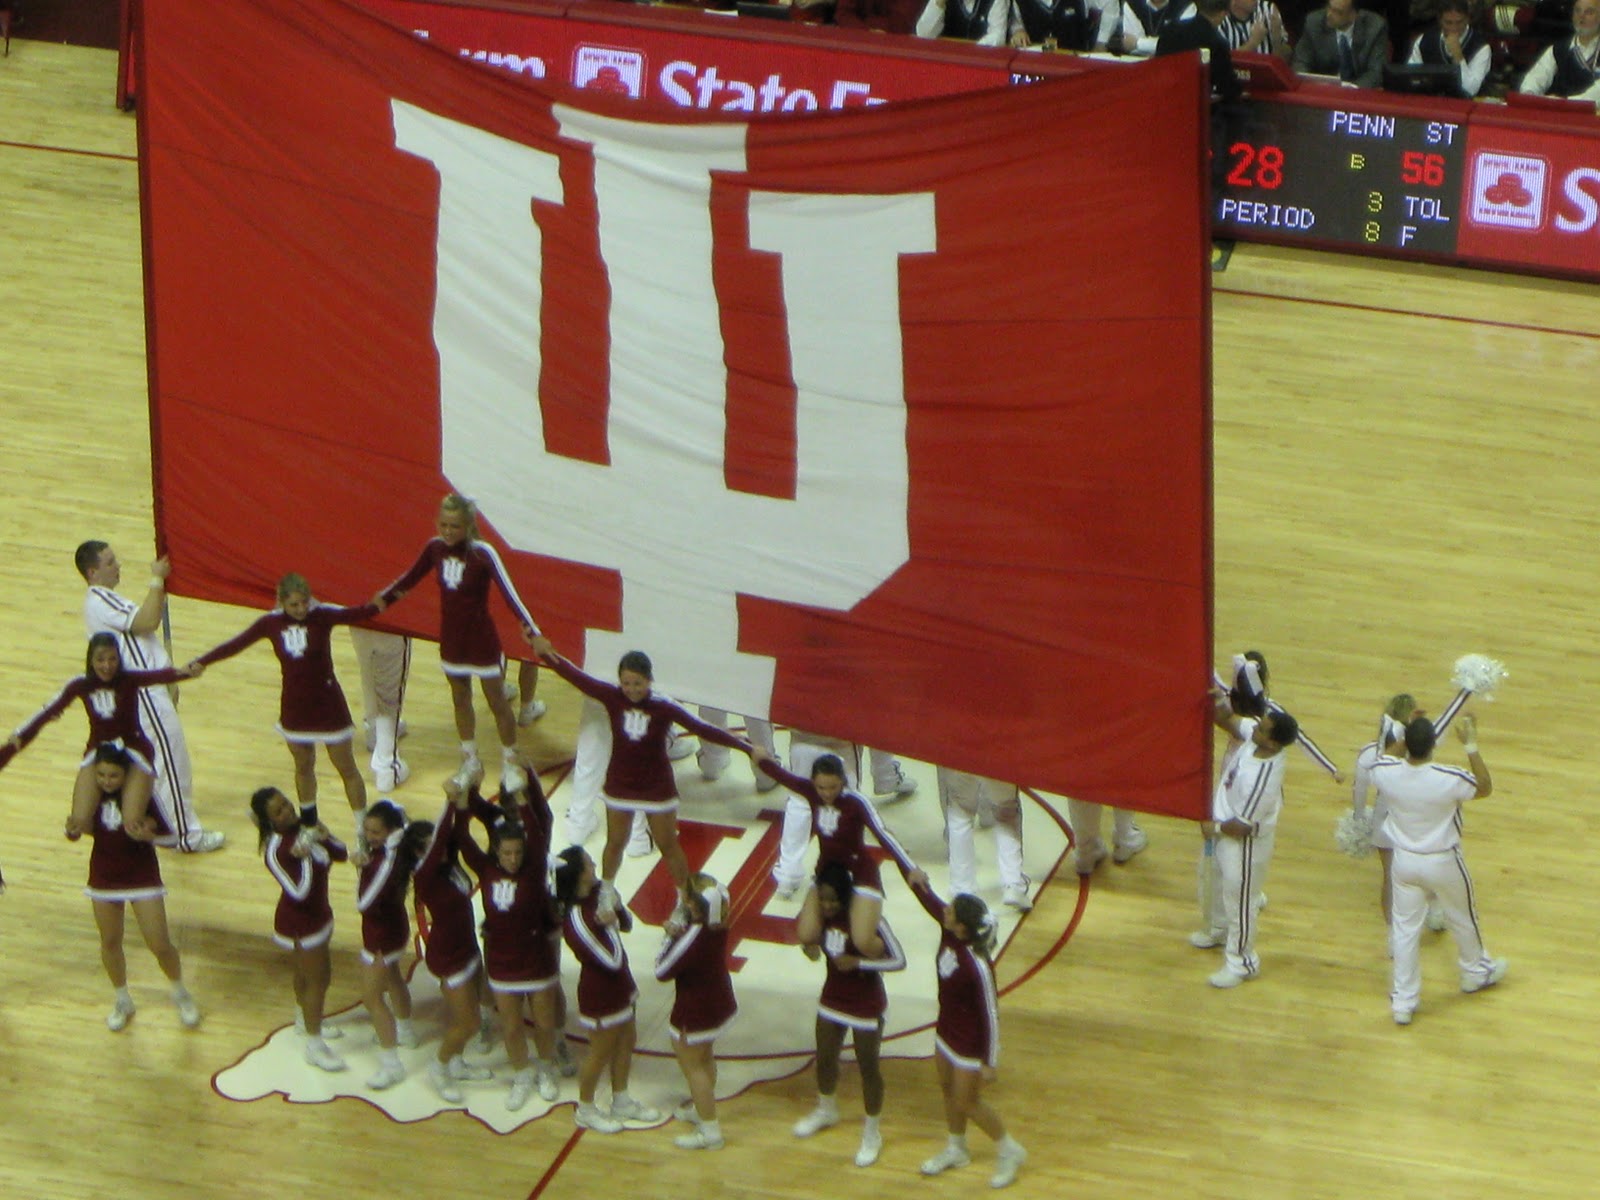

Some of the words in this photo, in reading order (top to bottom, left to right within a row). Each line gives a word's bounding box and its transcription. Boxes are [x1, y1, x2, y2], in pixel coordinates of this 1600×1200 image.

[1331, 110, 1397, 138] PENN
[1427, 121, 1459, 145] ST
[1227, 142, 1284, 190] 28
[1401, 151, 1446, 187] 56
[1221, 198, 1315, 230] PERIOD
[1368, 191, 1383, 213] 3
[1405, 195, 1450, 222] TOL
[1365, 221, 1381, 243] 8
[1401, 225, 1417, 247] F
